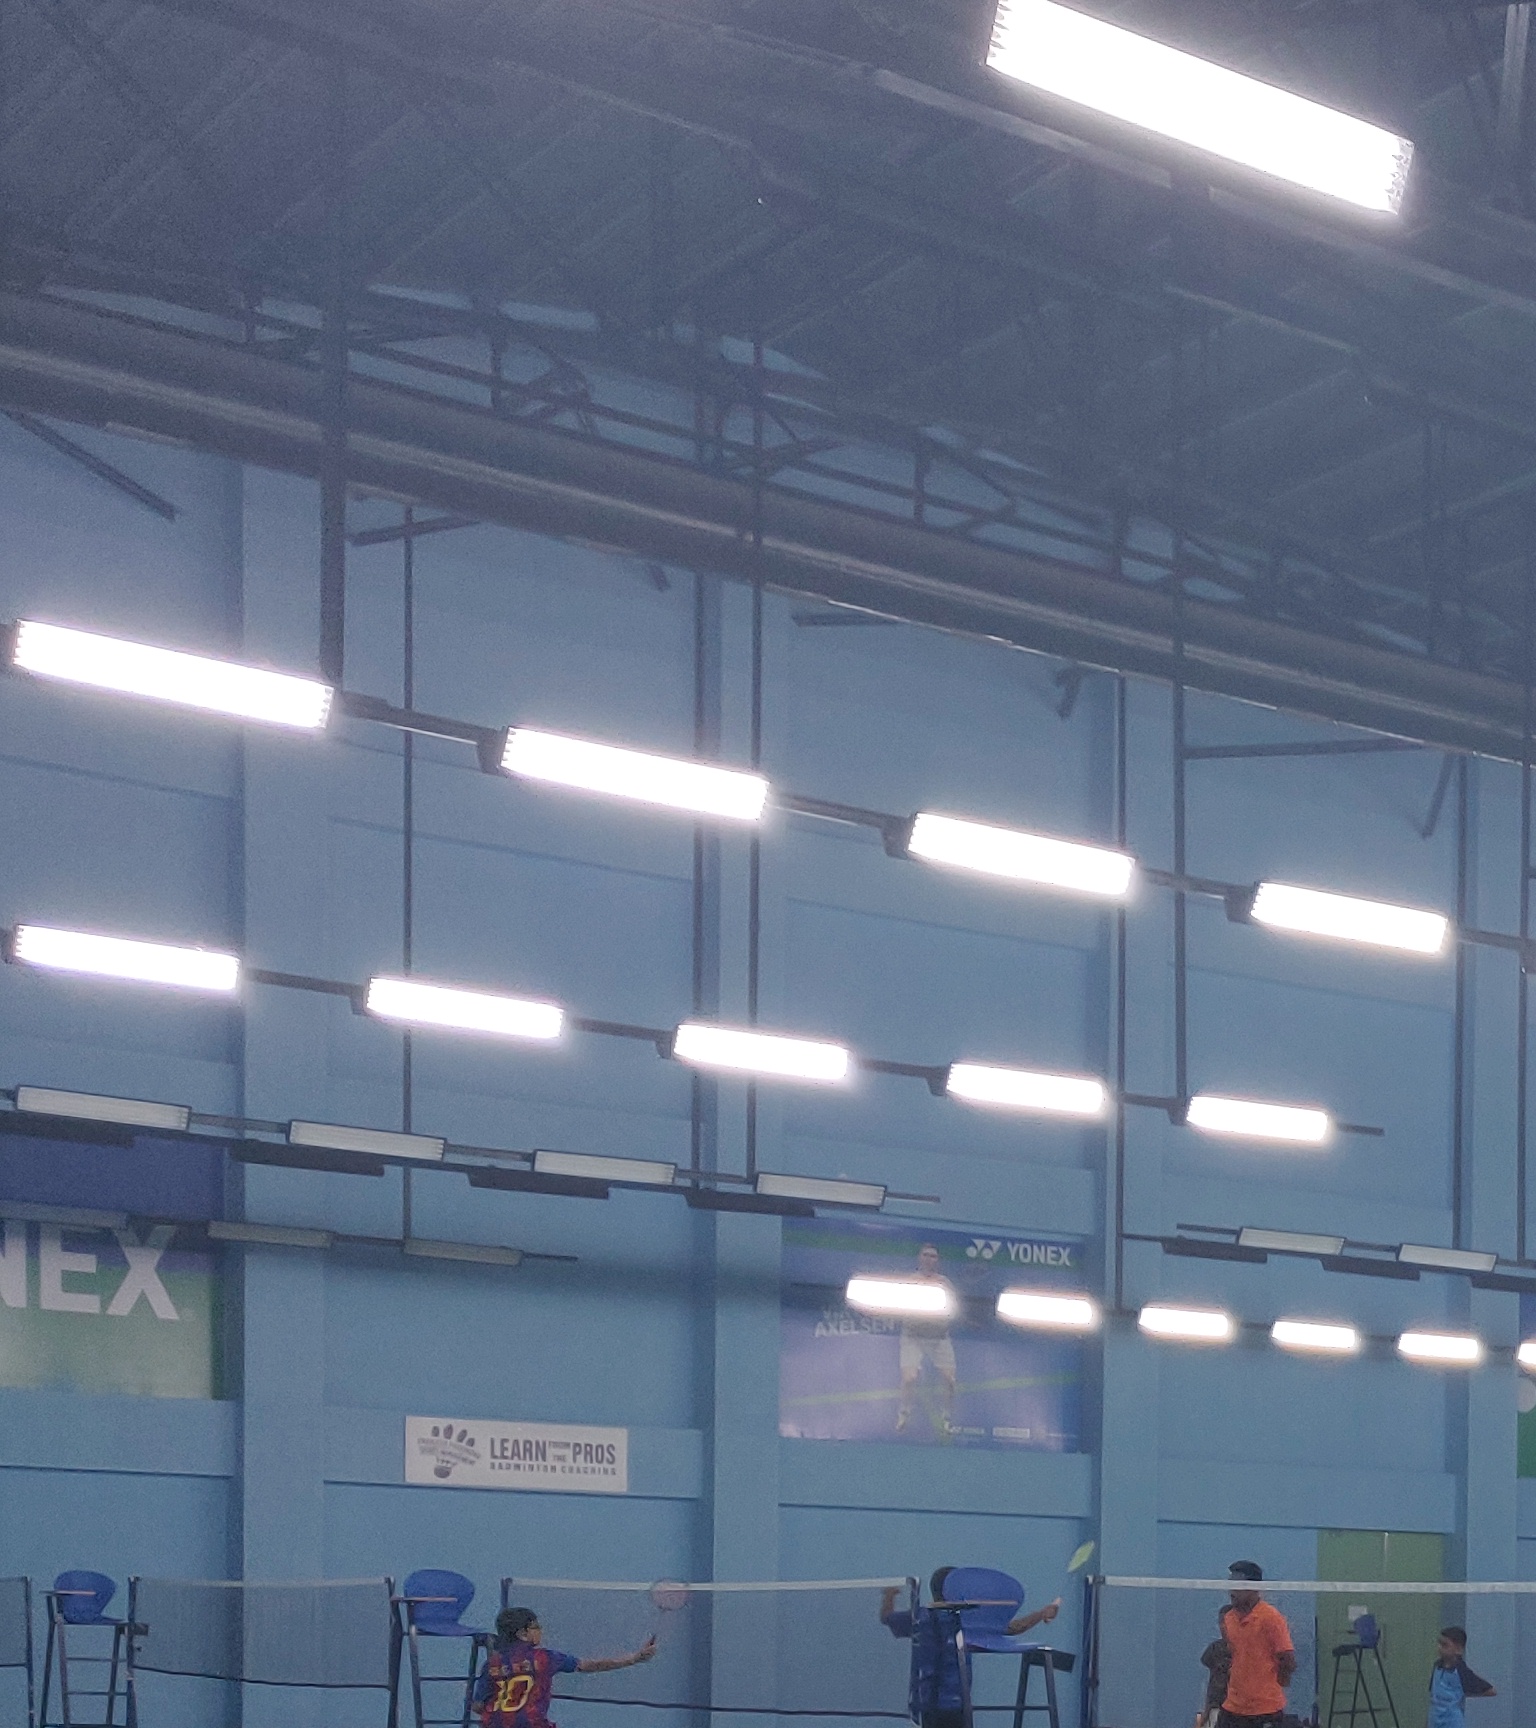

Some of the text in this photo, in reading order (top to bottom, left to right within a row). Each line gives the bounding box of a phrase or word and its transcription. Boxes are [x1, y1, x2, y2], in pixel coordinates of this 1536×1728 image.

[1007, 1242, 1071, 1267] YONEX
[490, 1437, 547, 1463] LEARN
[572, 1441, 616, 1465] PROS
